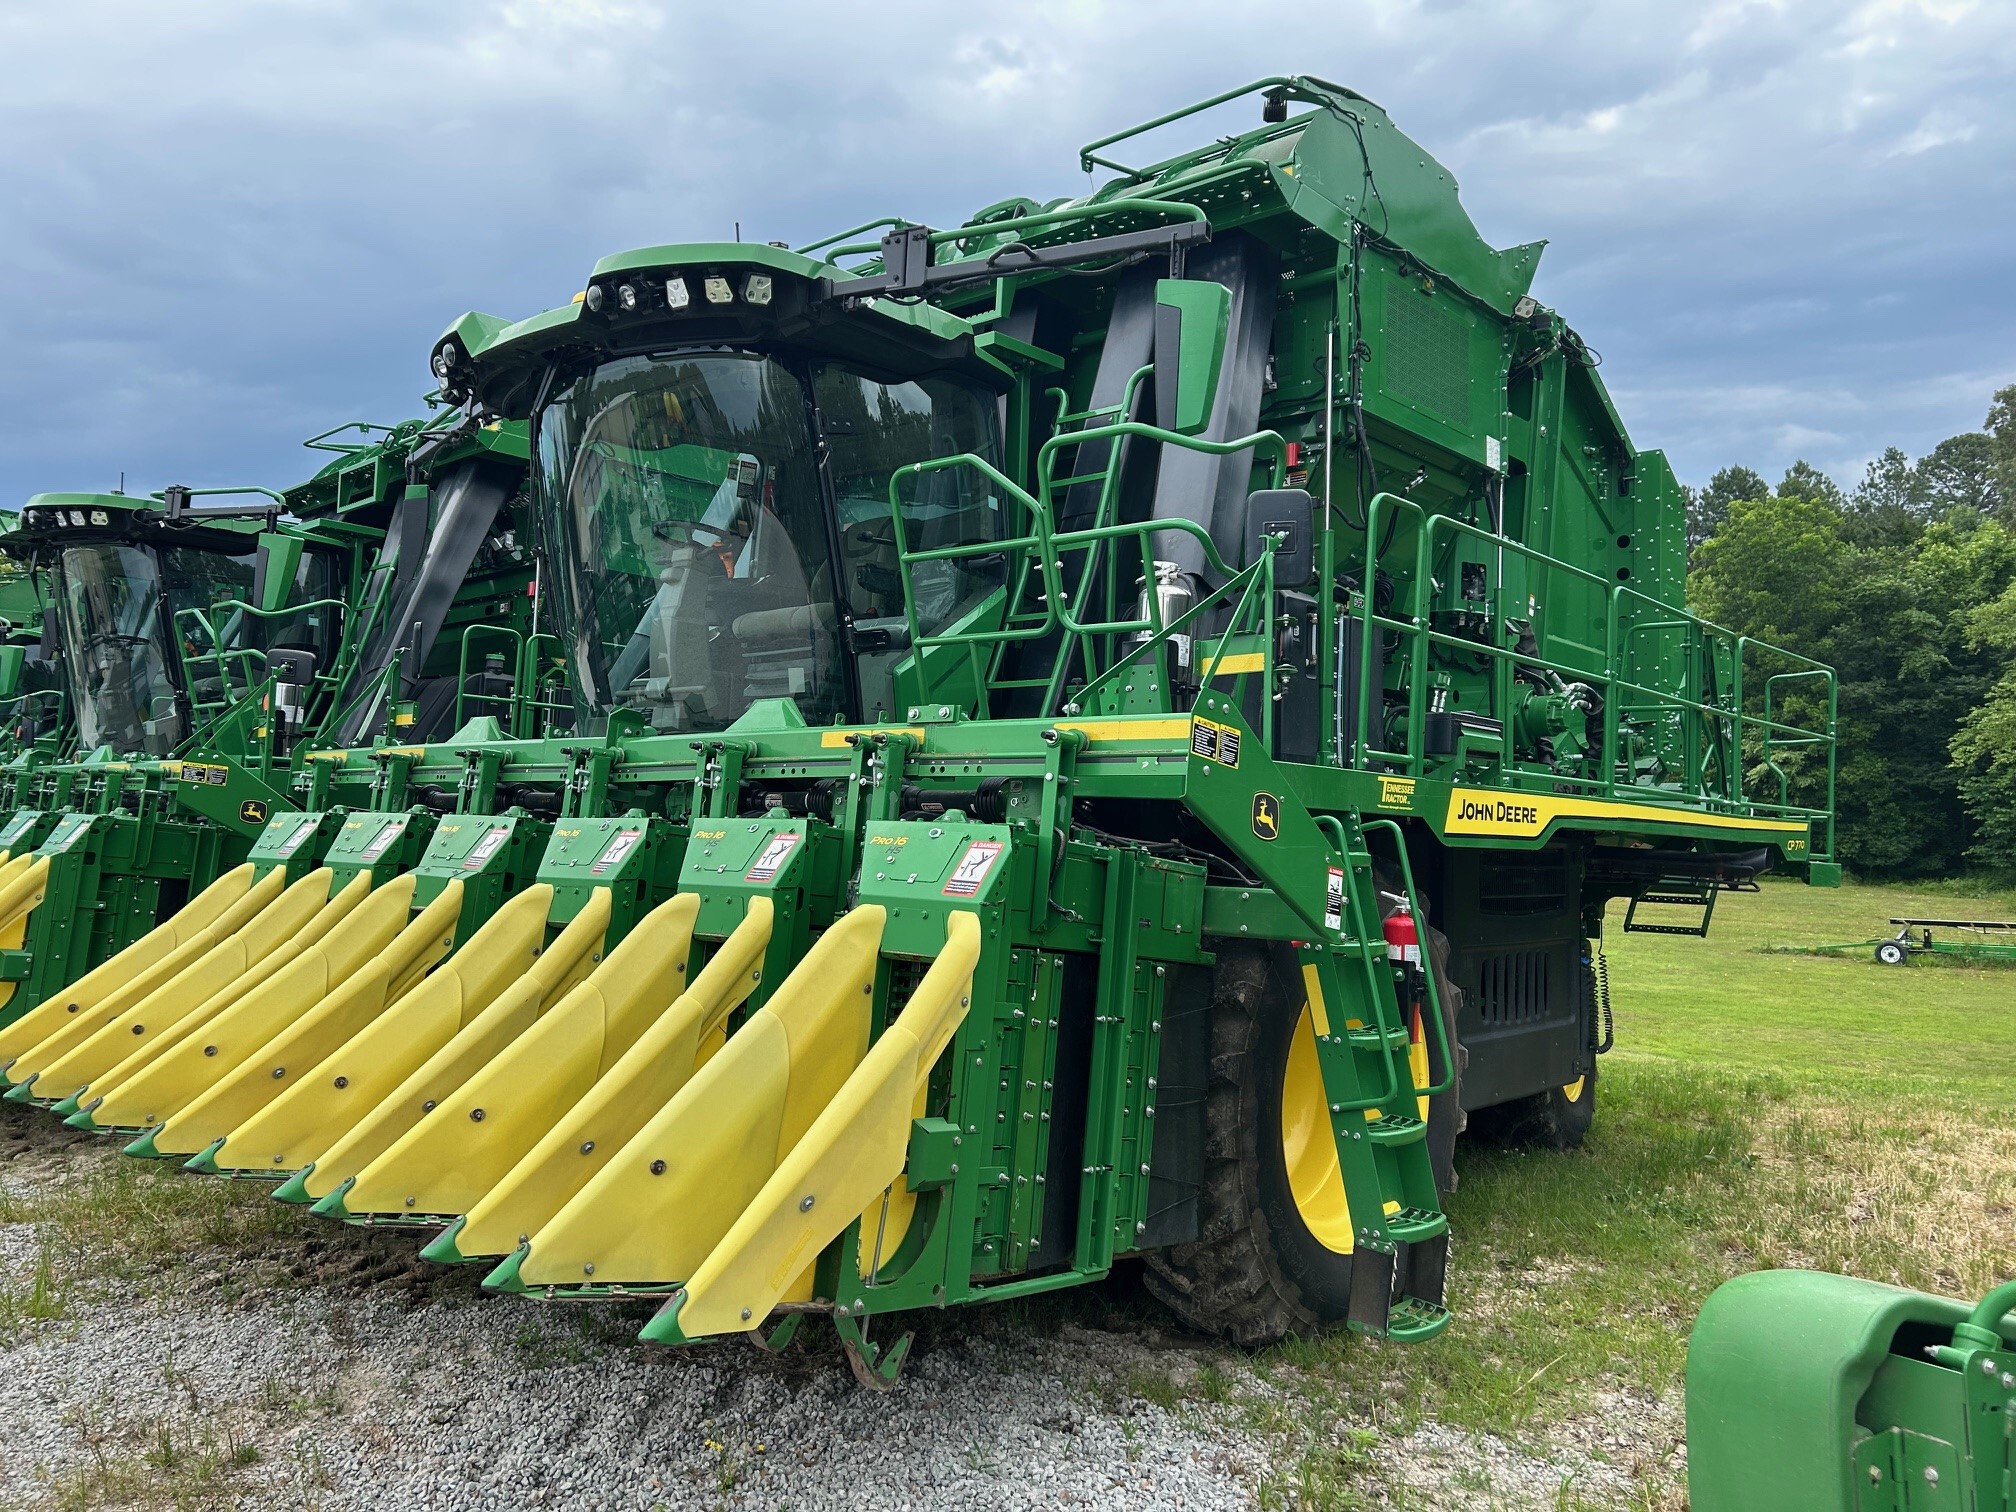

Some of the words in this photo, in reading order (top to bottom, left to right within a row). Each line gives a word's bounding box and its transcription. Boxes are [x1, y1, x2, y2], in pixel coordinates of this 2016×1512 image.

[1378, 776, 1415, 796] TENNESSEE
[1457, 799, 1493, 821] JOHN
[1496, 801, 1537, 824] DEERE
[693, 831, 714, 839] PRO
[712, 831, 727, 839] 16
[869, 836, 893, 845] PRO
[893, 836, 909, 845] 16
[1795, 840, 1805, 851] 770
[884, 846, 903, 854] HS
